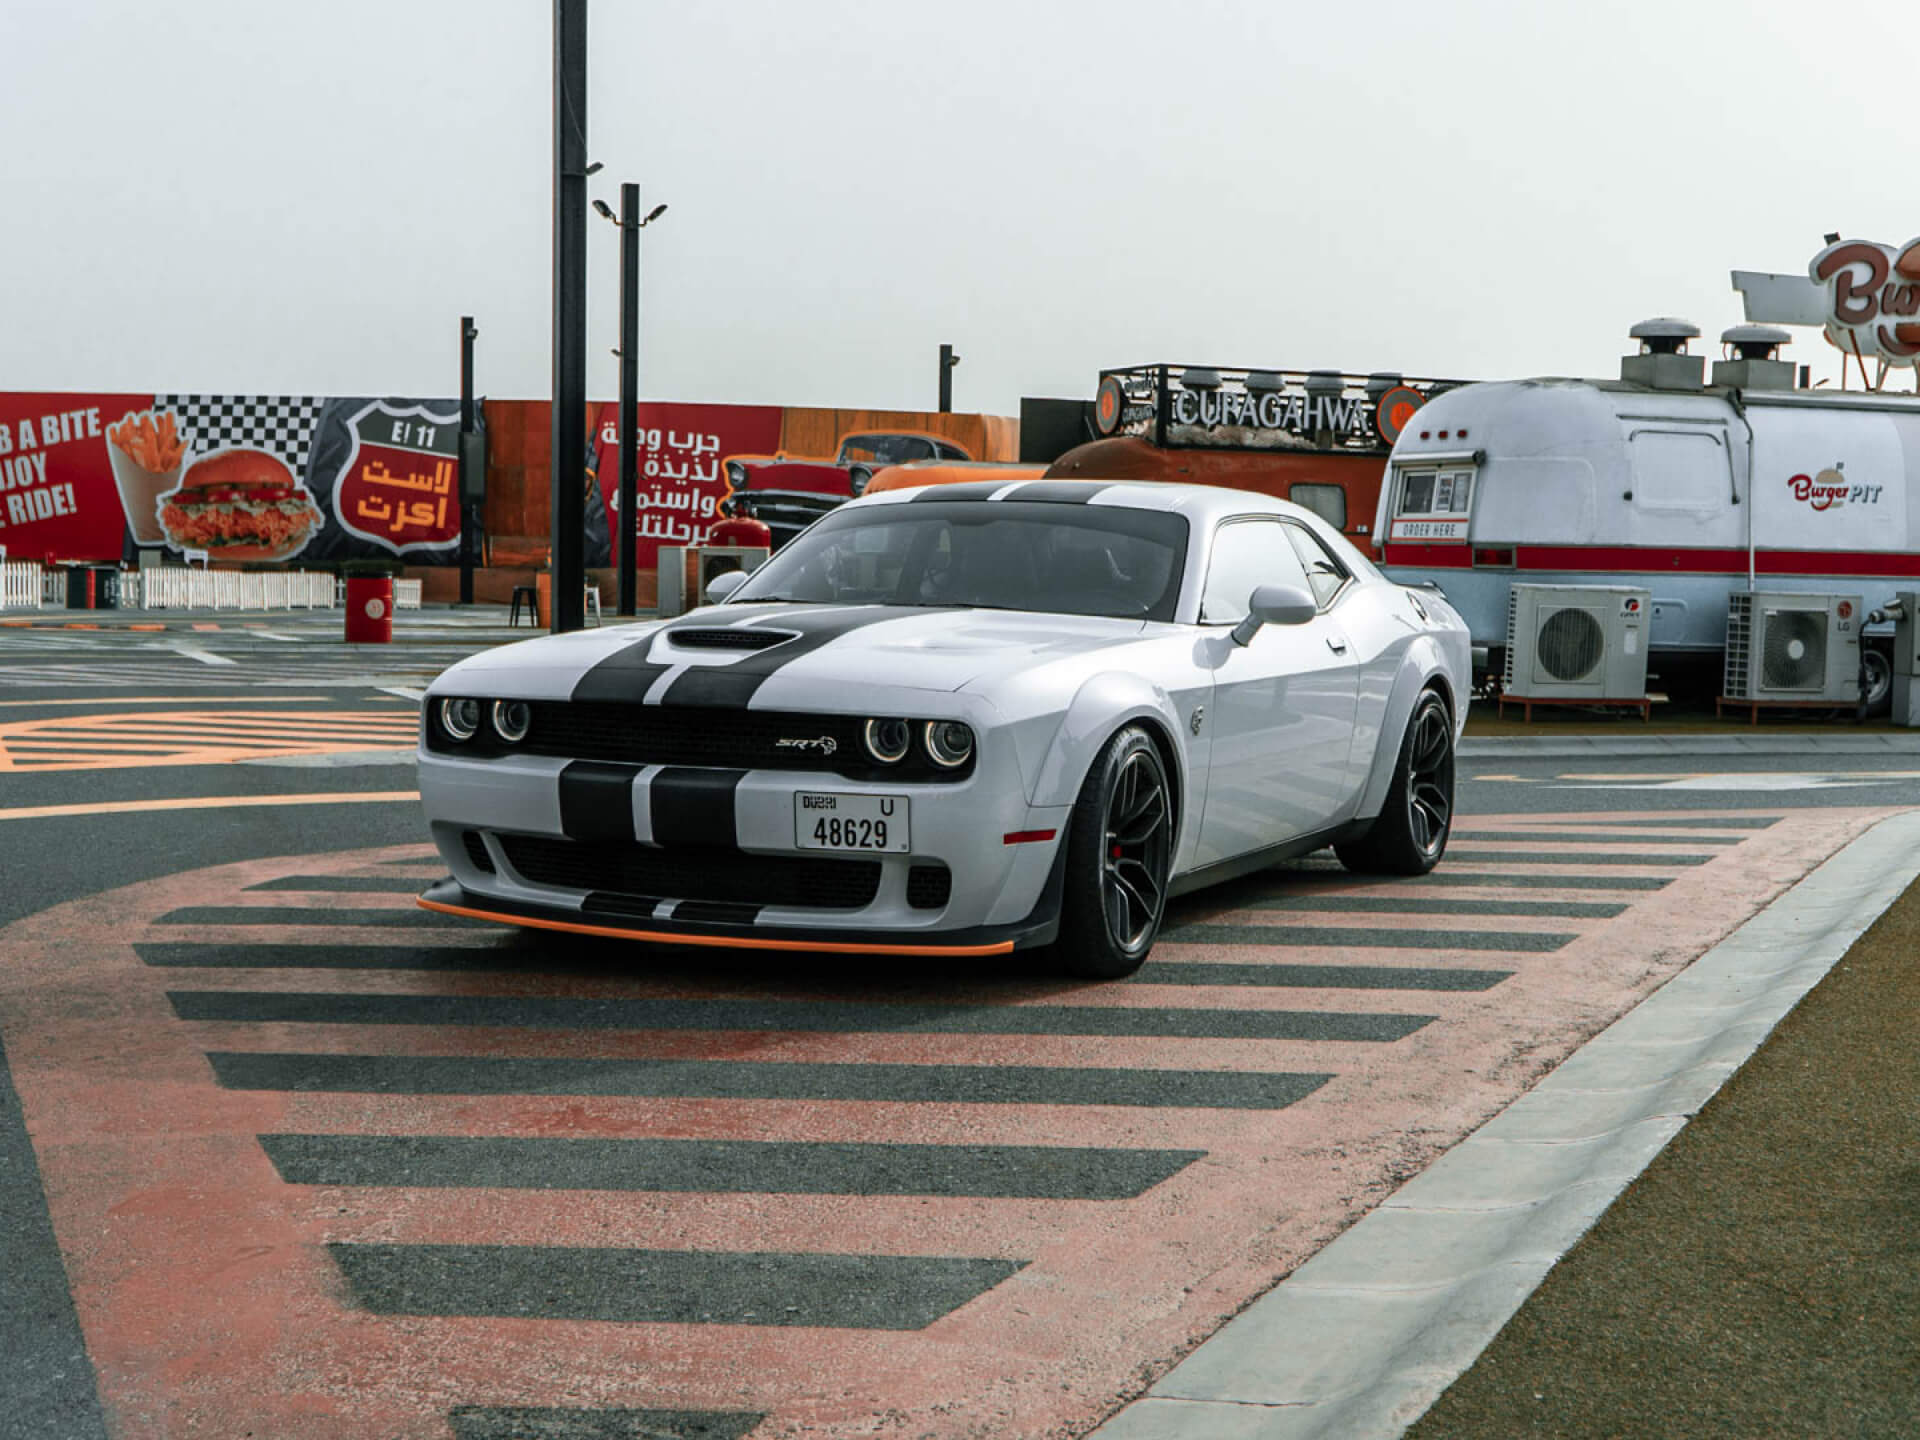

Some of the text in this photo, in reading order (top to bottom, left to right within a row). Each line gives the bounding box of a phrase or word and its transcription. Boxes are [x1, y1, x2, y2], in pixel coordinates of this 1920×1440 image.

[1175, 390, 1370, 432] CUPAGAHWA
[19, 419, 37, 450] A
[41, 407, 101, 446] BITE
[416, 425, 436, 448] 11
[601, 421, 720, 458] جرب وة
[644, 453, 719, 486] لذيذة
[7, 482, 77, 526] RIDE!
[609, 484, 716, 518] وإستم
[1788, 474, 1883, 512] Burger PIT
[1403, 523, 1456, 537] ORDER HERE
[1838, 621, 1850, 632] LG
[880, 799, 895, 817] U
[813, 816, 888, 849] 48629
